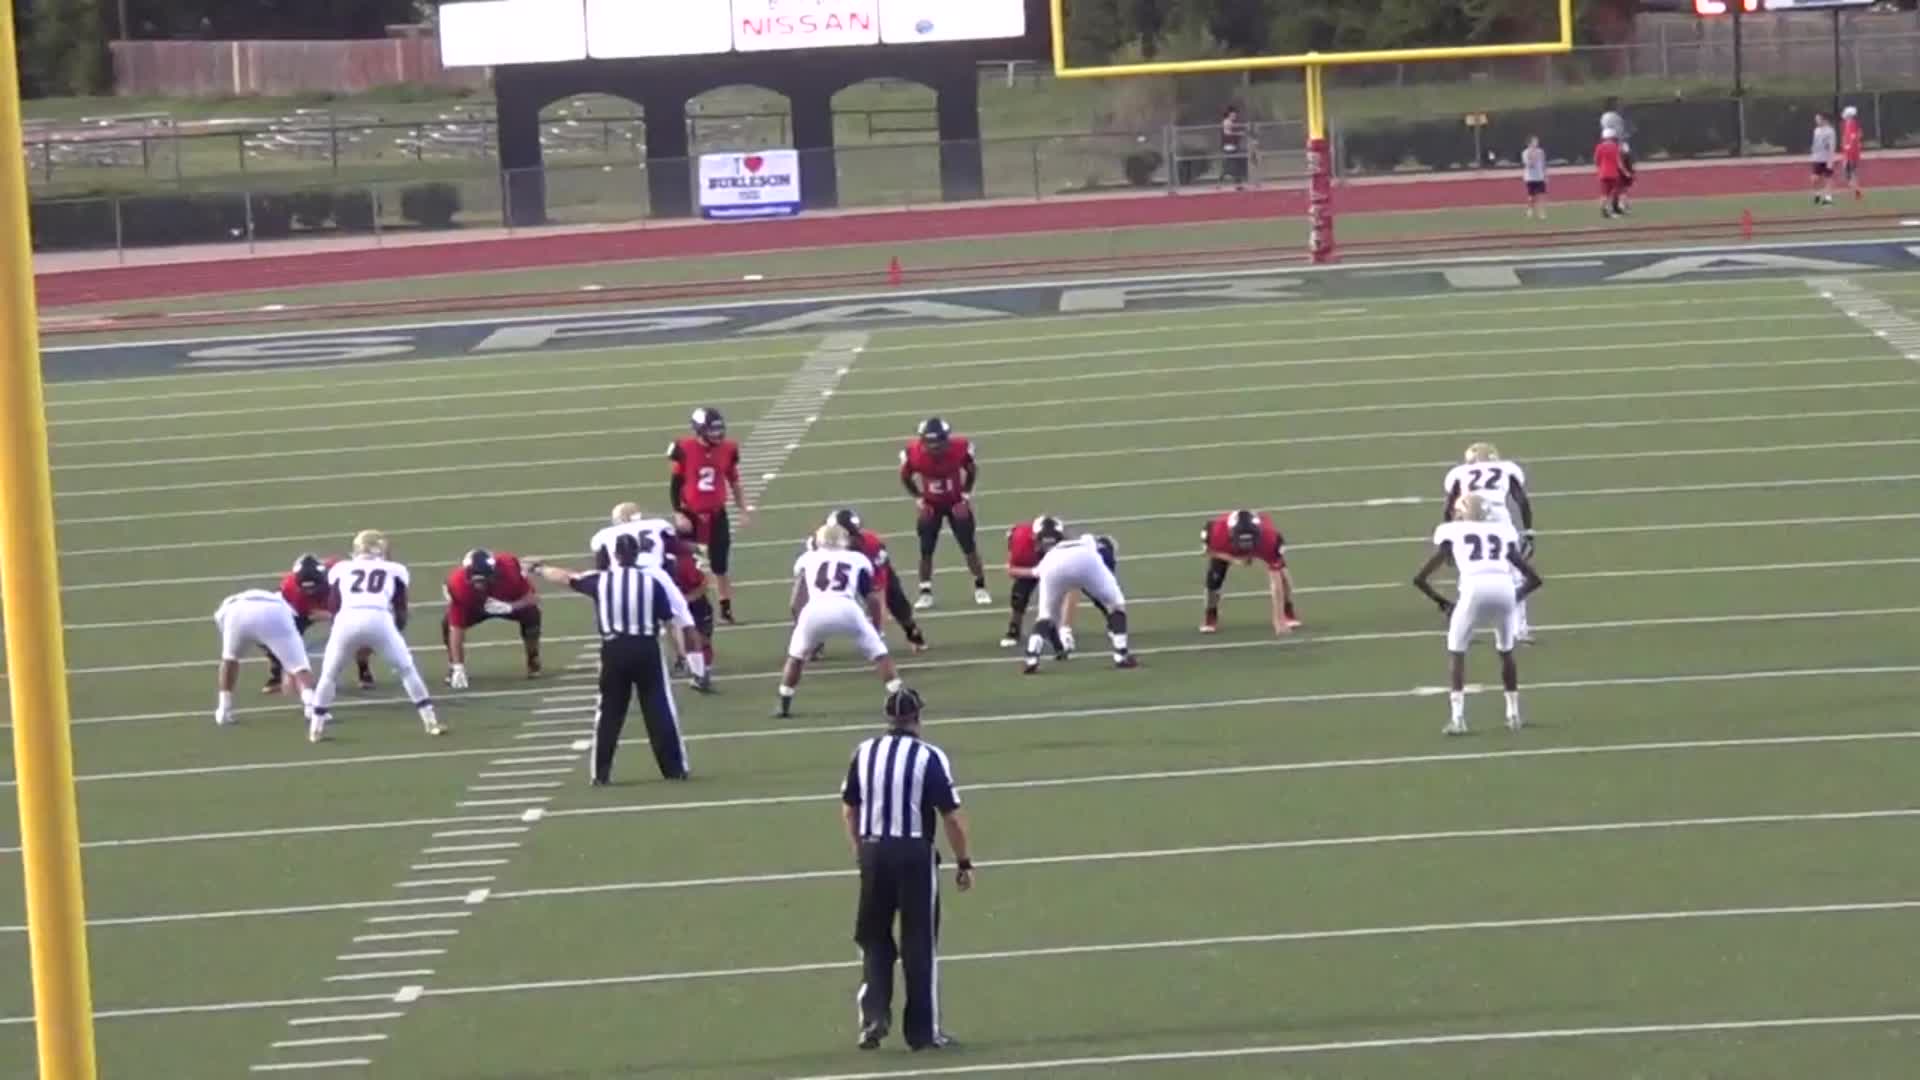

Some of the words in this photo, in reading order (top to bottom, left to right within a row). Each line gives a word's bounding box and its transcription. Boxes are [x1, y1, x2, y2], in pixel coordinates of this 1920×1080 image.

[742, 13, 870, 36] NISSAN
[698, 467, 715, 491] 2
[1468, 468, 1502, 491] 22
[1464, 533, 1502, 561] 23
[350, 569, 387, 594] 20
[814, 560, 852, 592] 45
